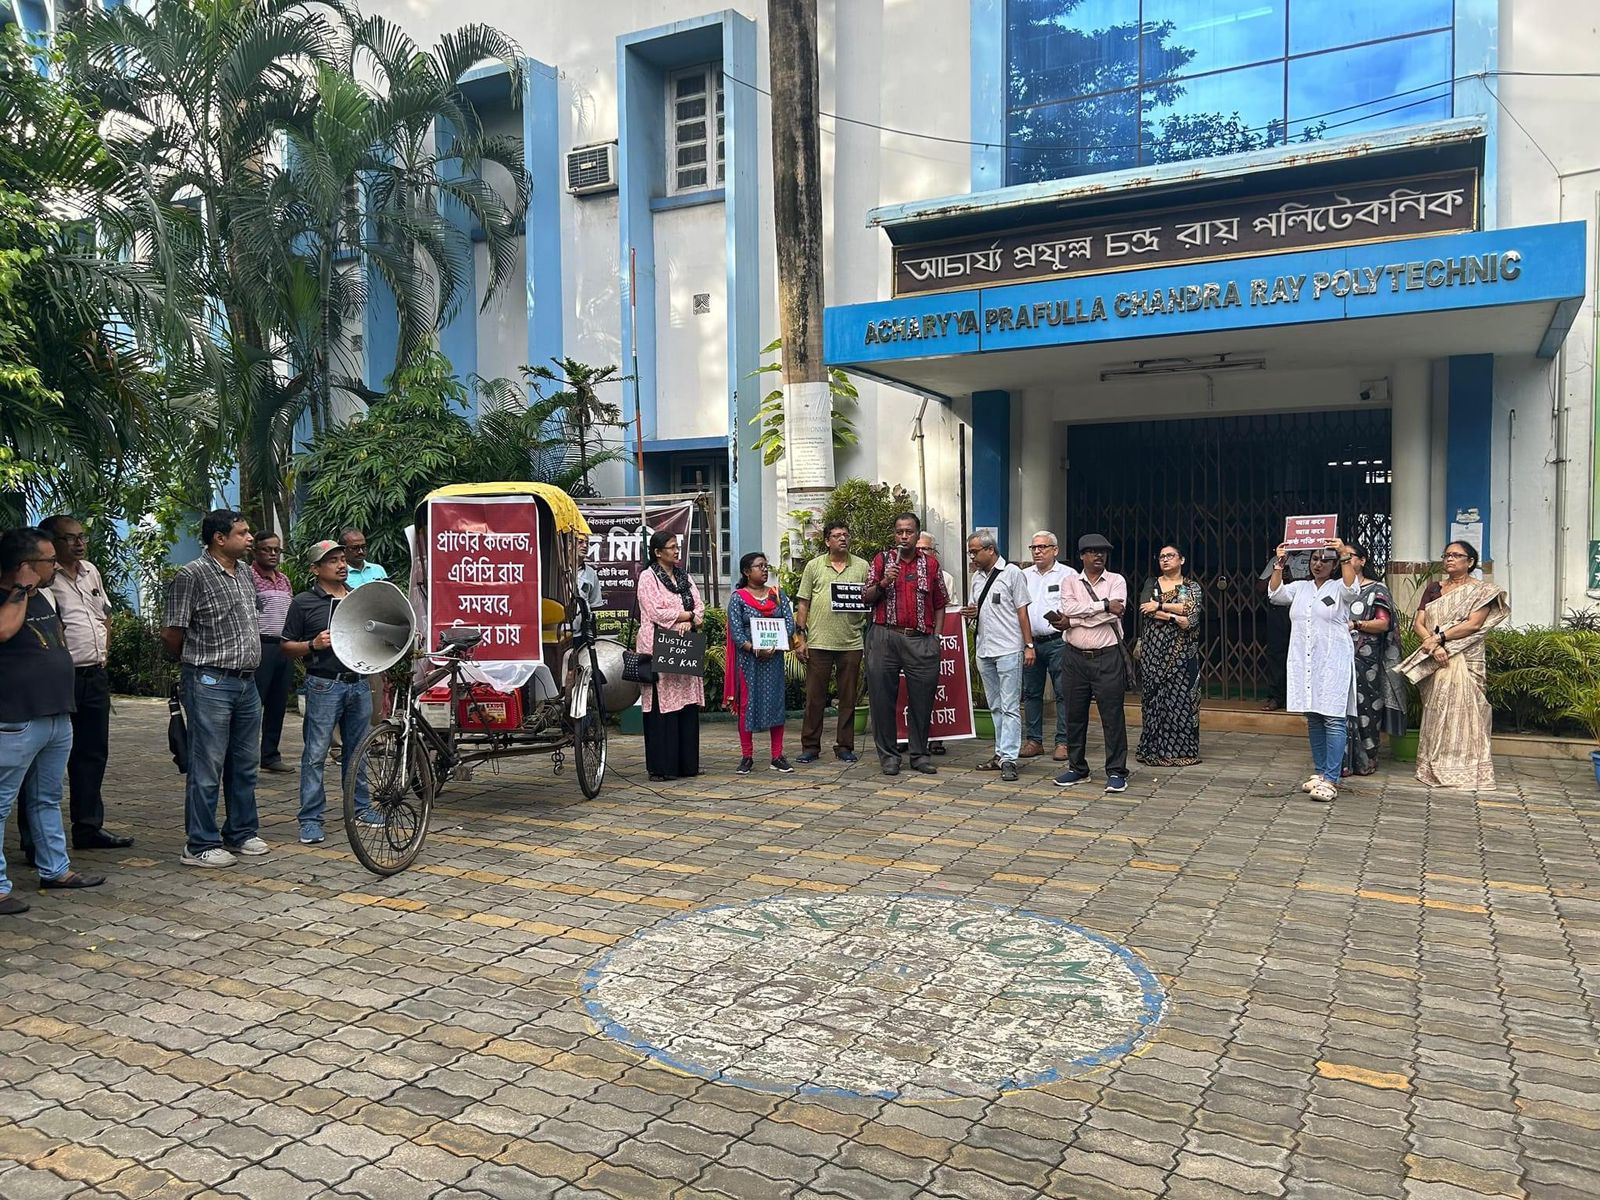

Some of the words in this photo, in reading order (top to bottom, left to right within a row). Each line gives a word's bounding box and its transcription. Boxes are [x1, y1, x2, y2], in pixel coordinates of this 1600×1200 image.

[1013, 236, 1093, 271] প্রফুল্ল
[1105, 227, 1162, 257] চন্দ্র
[1175, 217, 1241, 249] রায়
[1252, 188, 1465, 237] পলিটেকনিক
[985, 296, 1107, 333] PRAFULLA
[1114, 280, 1242, 318] CHANDRA
[1250, 275, 1306, 305] RAY
[1312, 250, 1521, 300] POLYTECHNIC
[437, 530, 480, 553] প্রাণের
[482, 532, 533, 555] কলেজ,
[448, 557, 495, 582] এপিসি
[498, 561, 524, 584] রায়
[458, 595, 512, 617] সমস্বরে,
[495, 624, 520, 646] চায়
[670, 647, 687, 655] FOR
[679, 658, 698, 668] KAR
[935, 708, 956, 725] চায়
